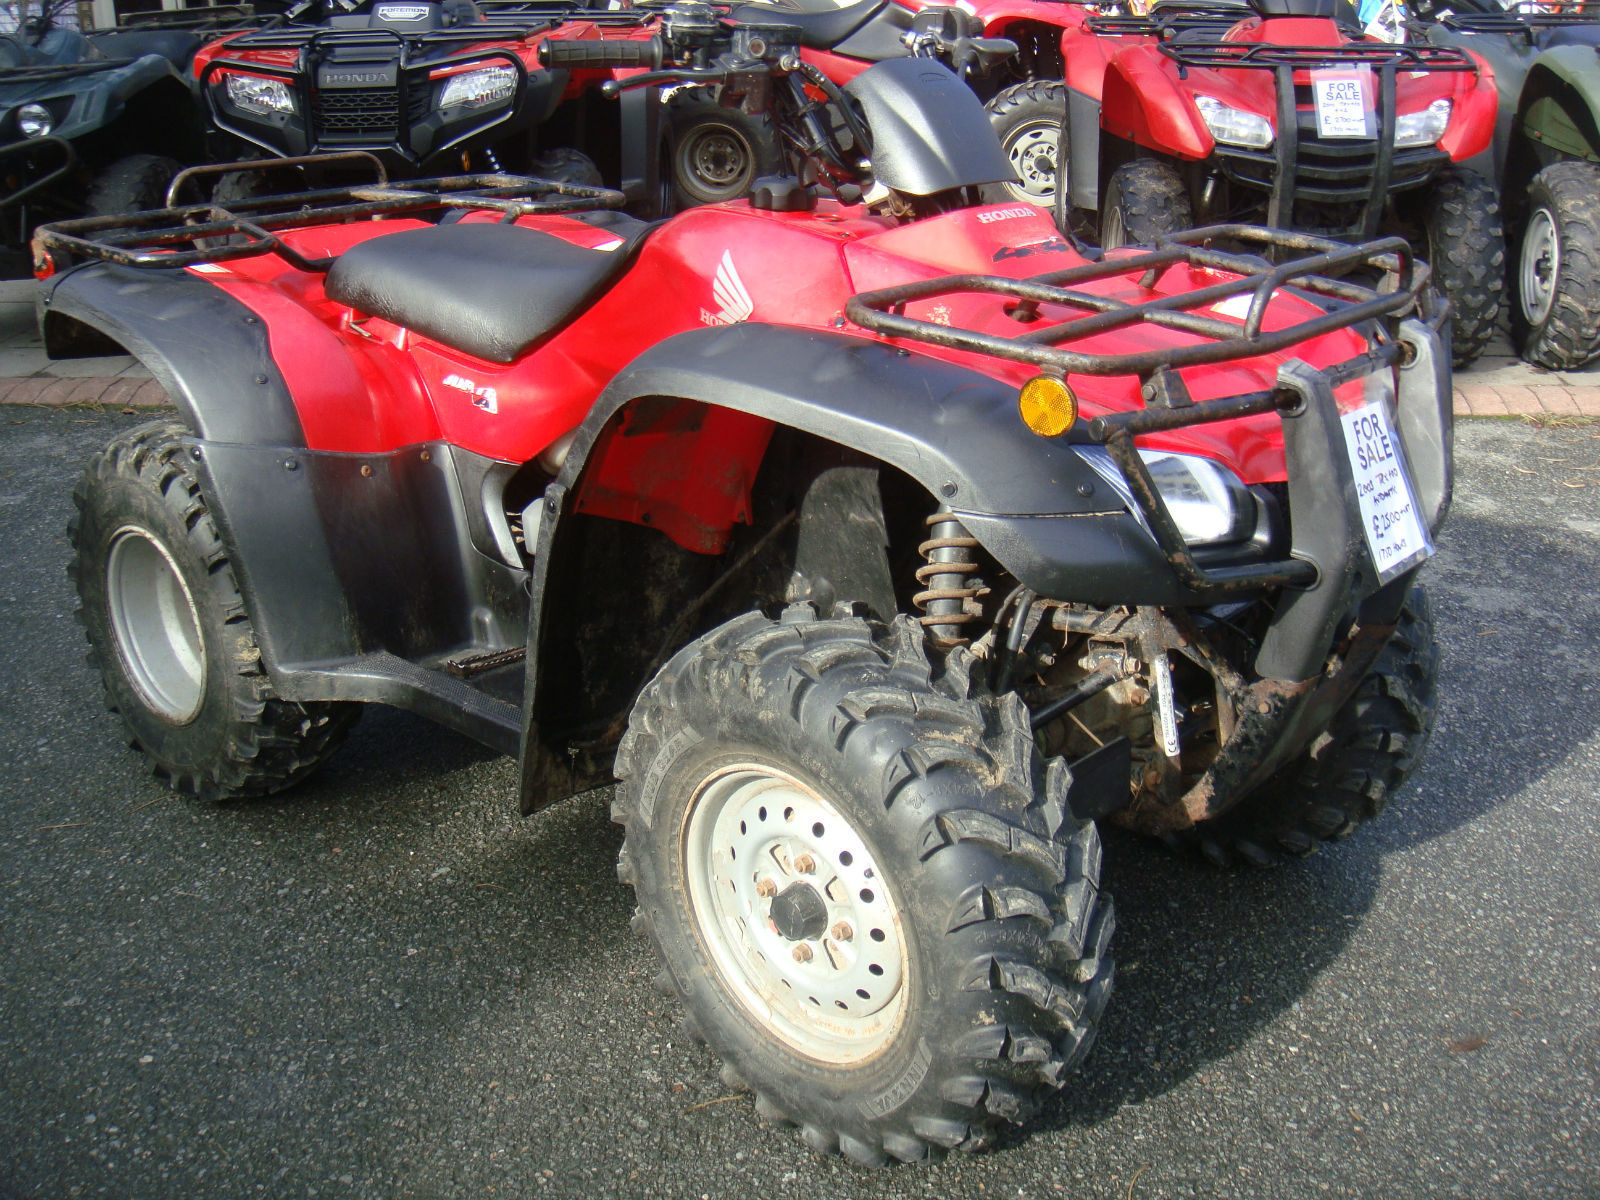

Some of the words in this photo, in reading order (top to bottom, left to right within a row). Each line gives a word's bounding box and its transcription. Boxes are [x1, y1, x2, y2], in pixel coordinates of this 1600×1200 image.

[326, 74, 389, 84] HONDA
[1329, 83, 1356, 91] FOR
[1326, 91, 1360, 101] SALE
[976, 207, 1037, 224] HONDA
[1352, 413, 1383, 445] FOR
[1357, 435, 1392, 471] SALE
